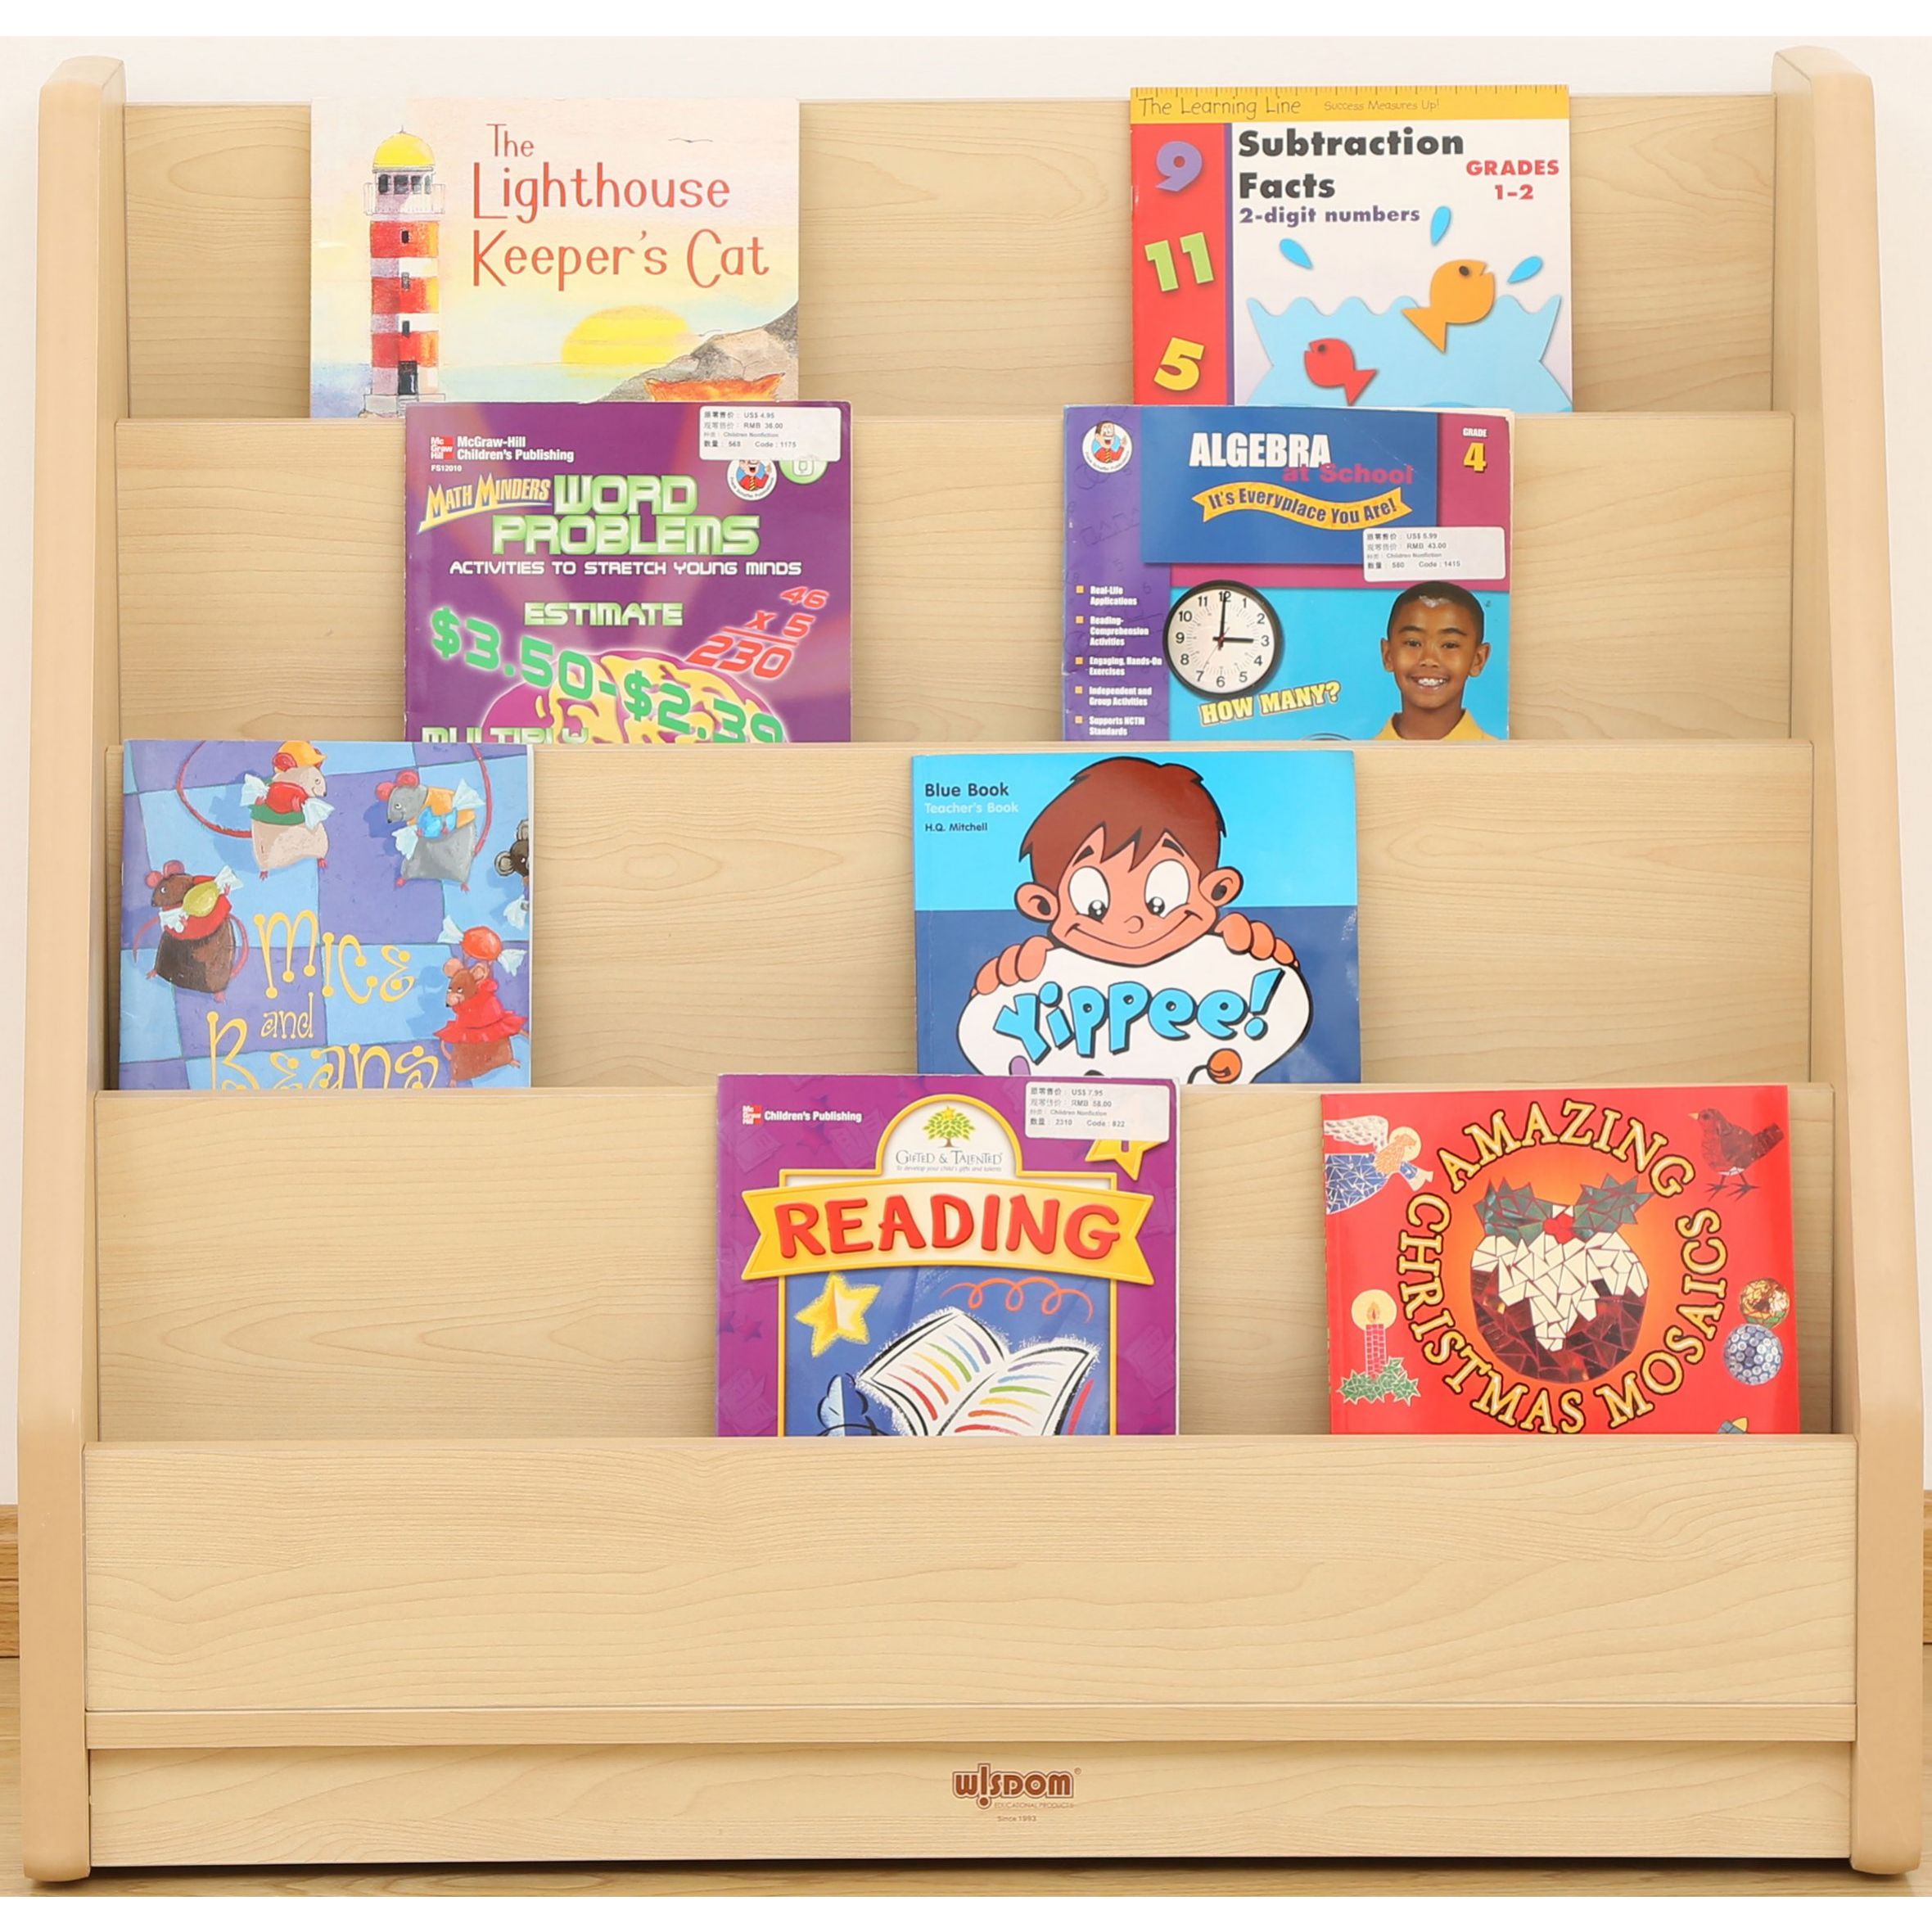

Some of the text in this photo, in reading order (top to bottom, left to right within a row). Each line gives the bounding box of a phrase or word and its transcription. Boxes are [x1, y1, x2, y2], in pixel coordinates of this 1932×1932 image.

[1139, 96, 1301, 120] The Learning Line
[1324, 98, 1440, 111] Success Measures Up!
[486, 123, 534, 157] The
[1239, 127, 1465, 157] Subtraction
[1155, 141, 1203, 192] 9
[1466, 160, 1560, 177] GRADES
[473, 161, 730, 223] Lighthouse
[1239, 172, 1336, 199] Facts
[1495, 183, 1533, 200] 1-2
[1239, 205, 1420, 224] 2-digit numbers
[473, 228, 770, 291] Keeper's Cat
[1144, 231, 1215, 291] 11
[1153, 336, 1204, 391] 5
[1462, 427, 1487, 438] GRADE
[431, 436, 444, 445] Mc
[458, 436, 526, 448] McGraw-Hill
[431, 451, 444, 459] Hill
[458, 449, 575, 463] Children's Publishing
[1189, 431, 1332, 468] ALGEBRA
[1462, 441, 1487, 473] 4
[1282, 462, 1414, 485] at School
[553, 475, 697, 515] WORD
[1208, 488, 1397, 525] It's Everyplace You Are!
[492, 515, 760, 555] PROBLEMS
[449, 561, 801, 576] ACTIVITIES TO STRETCH YOUNG MINDS
[1090, 585, 1123, 595] Real-Life
[1218, 590, 1231, 603] 12
[780, 586, 829, 609] 46
[1090, 597, 1137, 606] Applications
[1198, 596, 1208, 607] 11
[1243, 598, 1247, 608] 1
[524, 602, 684, 626] ESTIMATE
[1090, 616, 1124, 625] Reading-
[1179, 611, 1193, 622] 10
[1257, 613, 1265, 625] 2
[782, 612, 816, 639] 5
[1090, 627, 1149, 636] Comprehension
[1090, 637, 1125, 646] Activities
[1176, 632, 1185, 643] 9
[1261, 635, 1270, 647] 3
[685, 634, 793, 679] 230
[1089, 657, 1162, 666] Engaging, Hands-On
[1180, 653, 1189, 666] 8
[1254, 655, 1262, 666] 4
[1089, 667, 1125, 676] Exercises
[1196, 670, 1204, 682] 7
[1239, 671, 1248, 683] 5
[1216, 676, 1225, 688] 6
[1089, 686, 1152, 696] Independent and
[1089, 697, 1148, 706] Group Activities
[1199, 680, 1342, 727] HOW MANY?
[1089, 716, 1123, 726] Supports
[1089, 727, 1127, 736] Standards
[925, 782, 1009, 797] Blue Book
[924, 801, 1019, 814] Teacher's Book
[925, 822, 988, 832] H.Q. Mitchell
[260, 992, 314, 1040] and
[992, 968, 1285, 1065] Yippee!
[764, 1111, 862, 1123] Children's Publishing
[1438, 1099, 1695, 1198] AMAZING
[938, 1153, 947, 1163] &
[774, 1194, 1121, 1260] READING
[1396, 1193, 1728, 1434] CHRISTMAS MOSAICS
